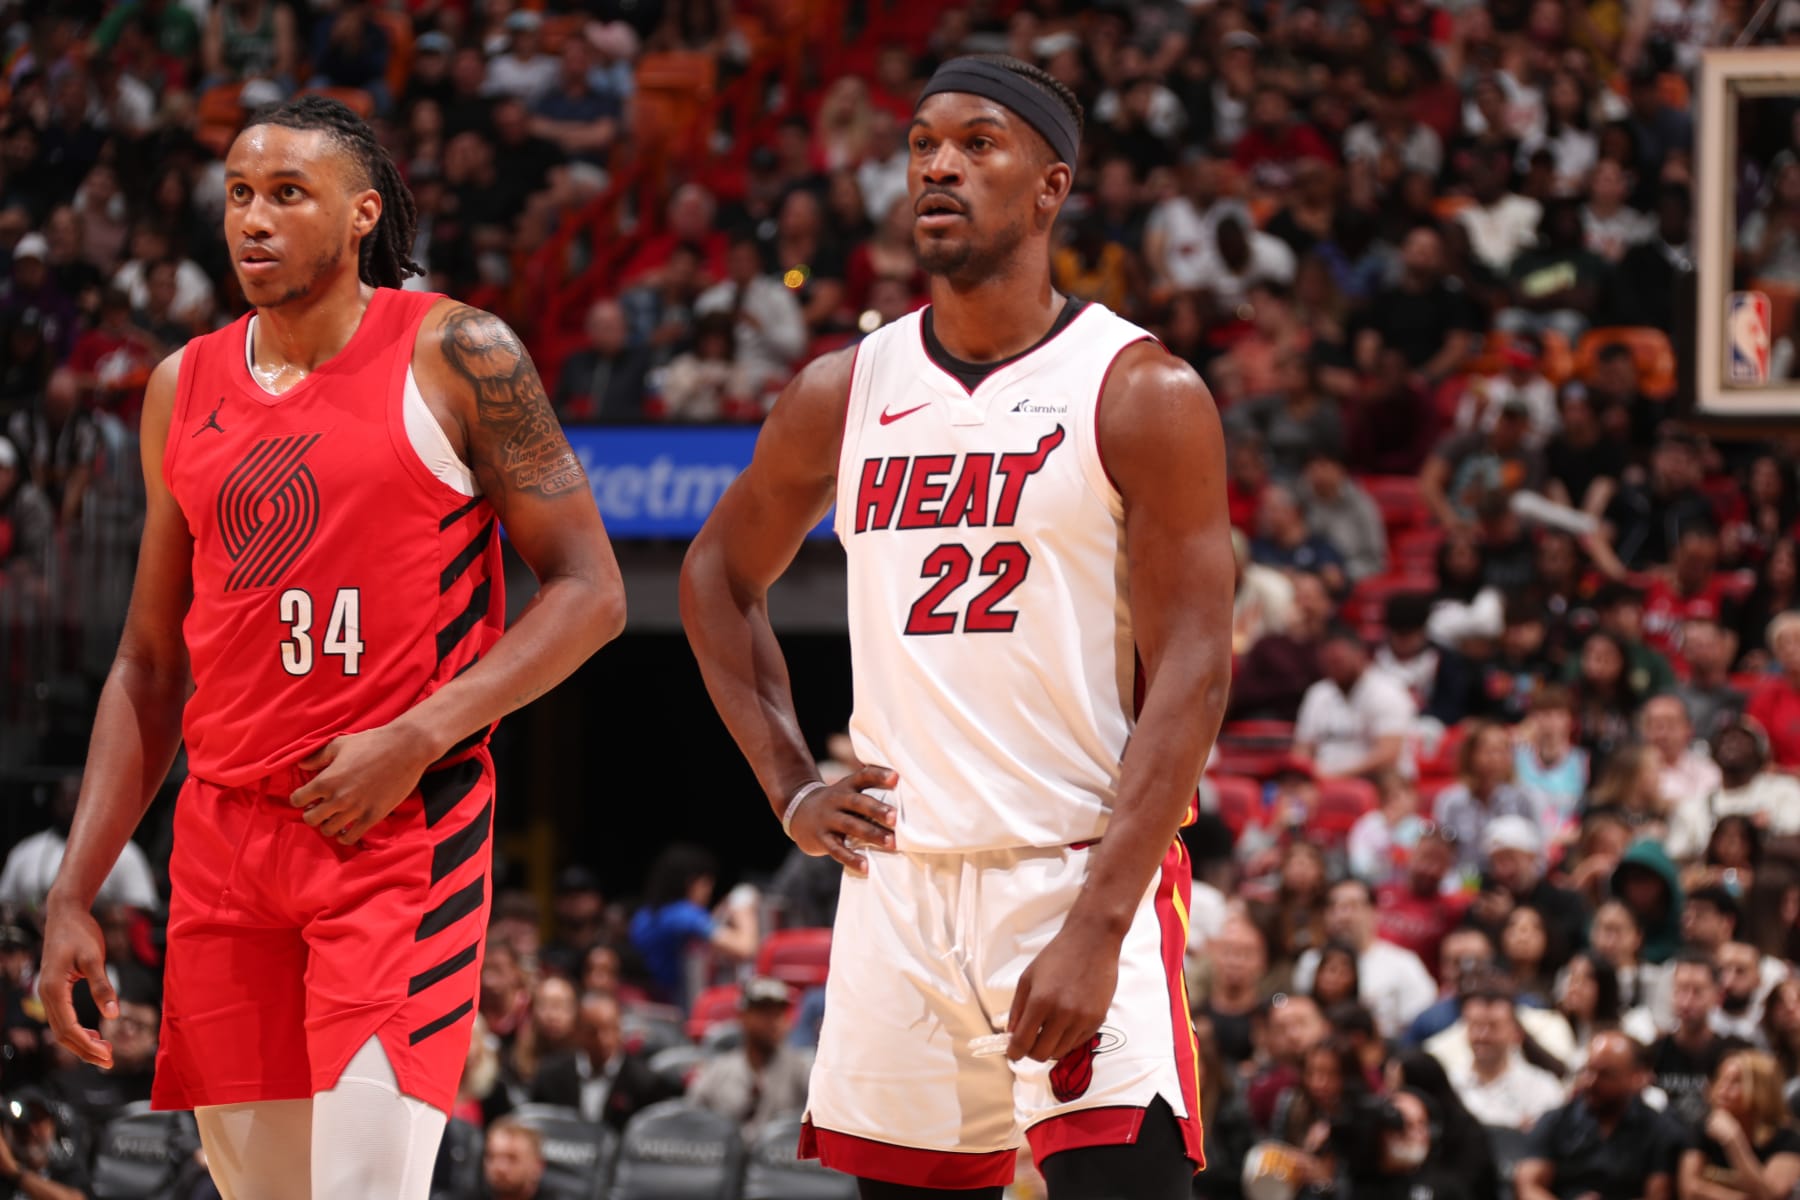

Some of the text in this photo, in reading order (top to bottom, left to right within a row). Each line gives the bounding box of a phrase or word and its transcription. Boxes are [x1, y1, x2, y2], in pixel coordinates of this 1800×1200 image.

[1023, 404, 1068, 414] Carnival
[855, 422, 1065, 535] HEAT
[280, 586, 365, 676] 34
[904, 541, 1031, 635] 22
